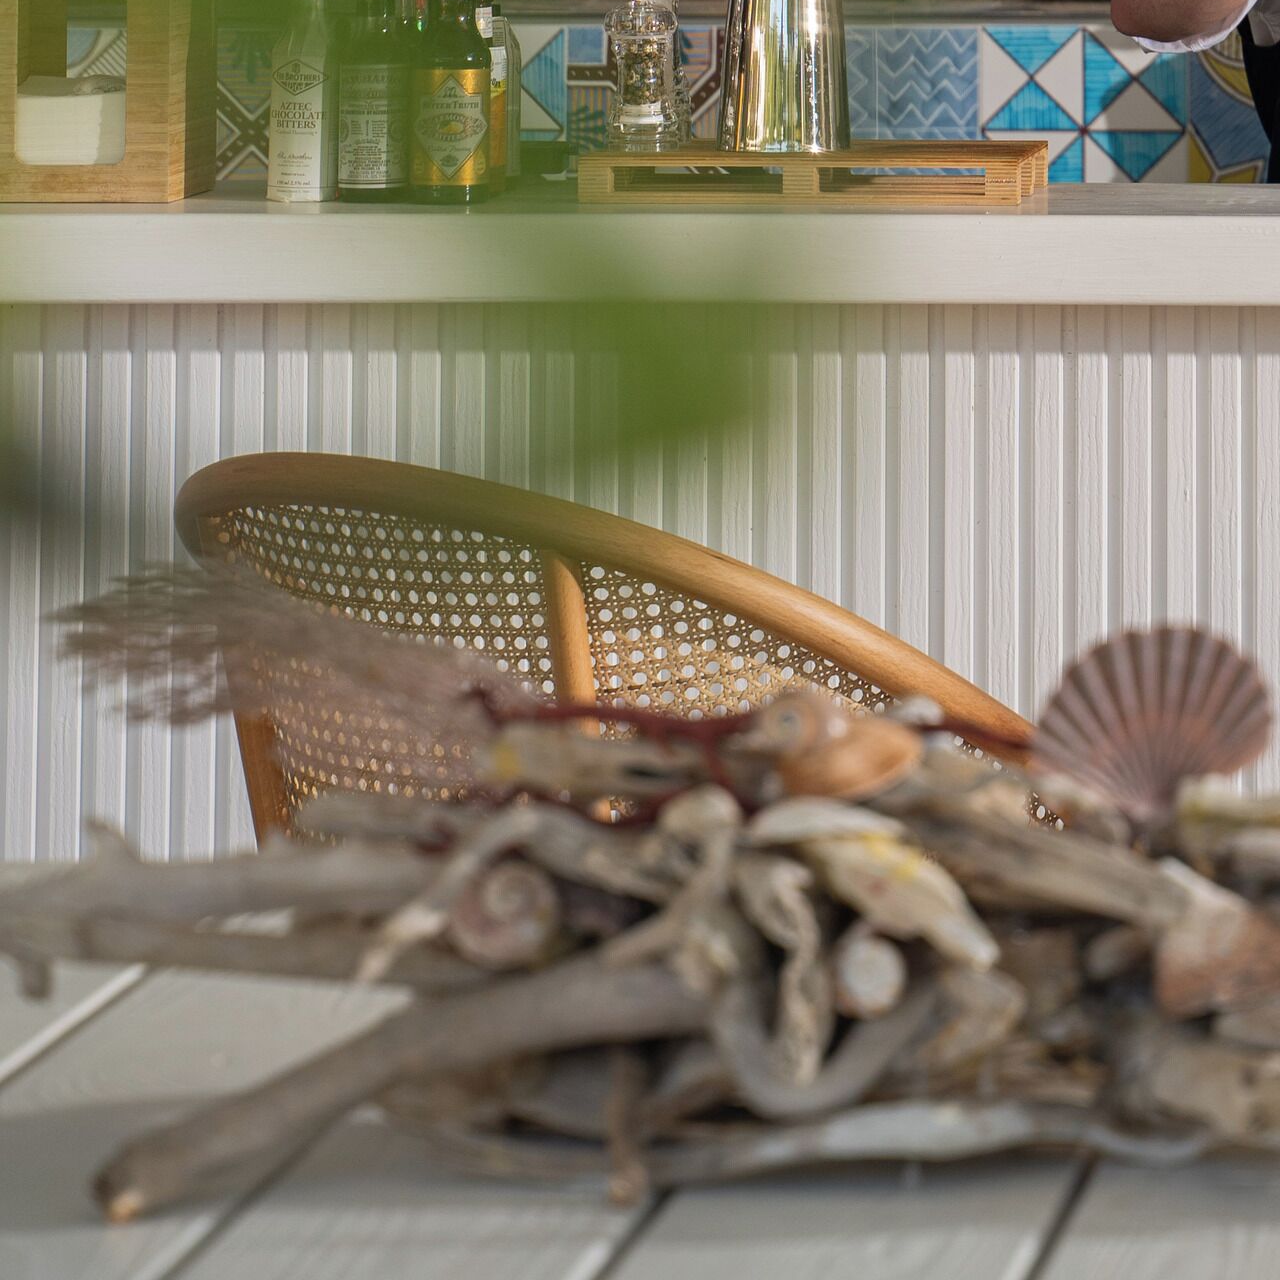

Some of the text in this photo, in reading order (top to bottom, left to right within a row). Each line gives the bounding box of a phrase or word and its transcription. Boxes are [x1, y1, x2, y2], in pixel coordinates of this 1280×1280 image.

[285, 71, 321, 81] BROTHERS
[280, 102, 312, 111] AZTEC
[452, 100, 480, 109] TRUTH
[271, 110, 327, 121] CHOCOLATE
[276, 120, 317, 129] BITTERS
